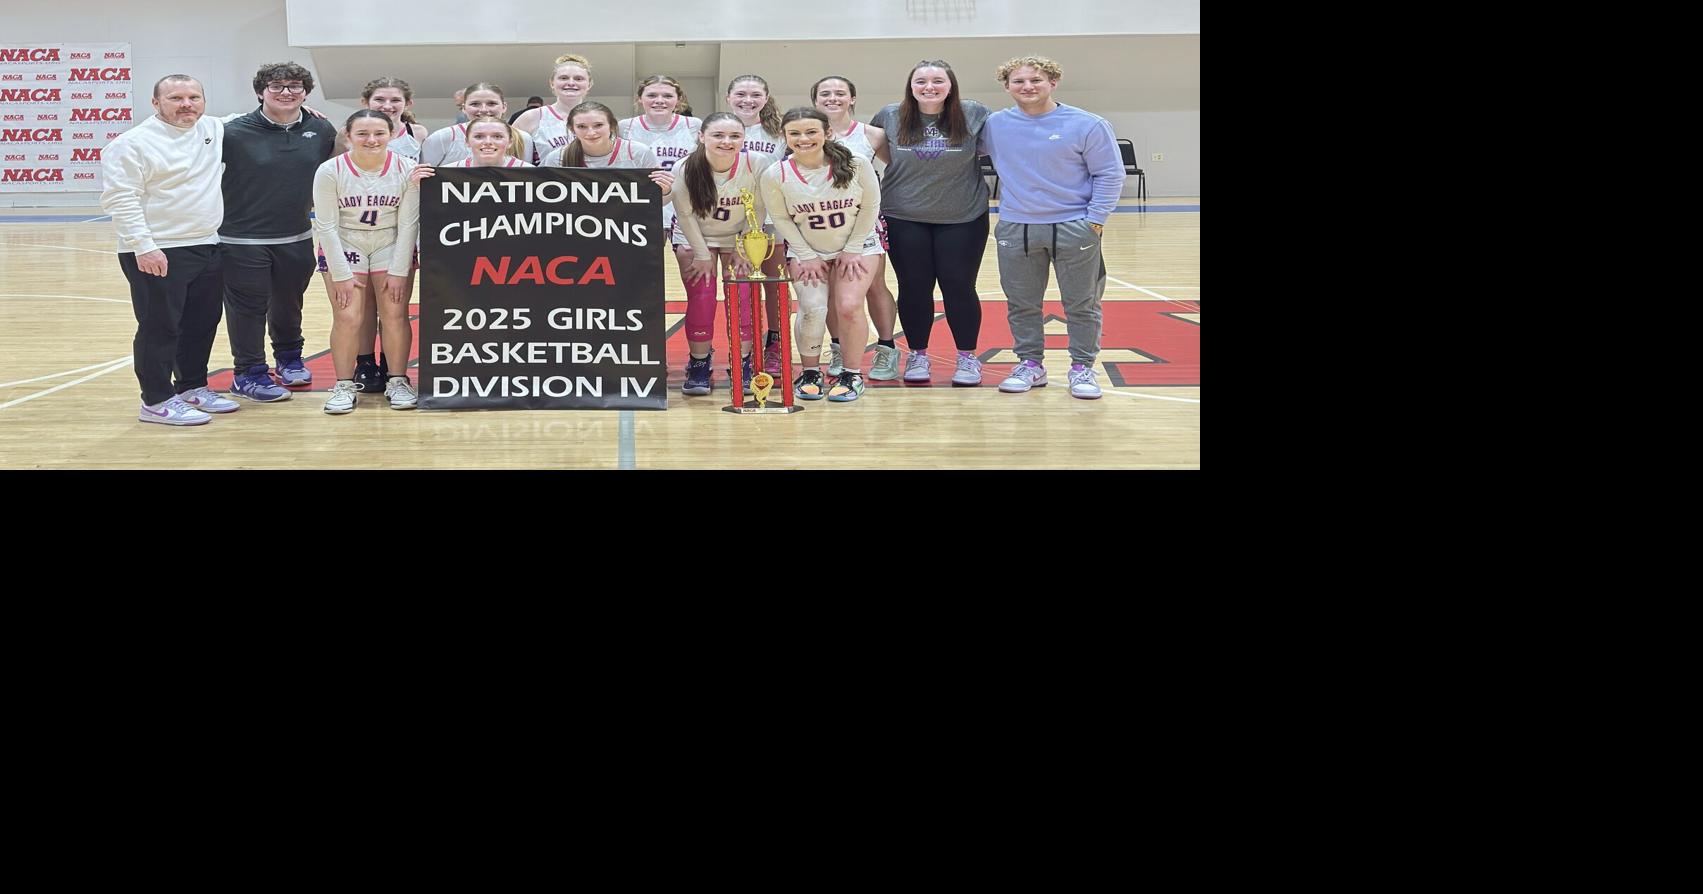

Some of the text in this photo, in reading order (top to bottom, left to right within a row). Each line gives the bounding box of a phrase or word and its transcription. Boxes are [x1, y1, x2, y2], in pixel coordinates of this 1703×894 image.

[0, 48, 60, 61] NACA
[68, 67, 131, 81] NACA
[0, 88, 61, 101] NACA
[69, 108, 132, 121] NACA
[0, 128, 63, 141] NACA
[548, 136, 569, 148] LADY
[70, 148, 102, 161] NA
[657, 146, 688, 158] EAGLES
[1, 168, 64, 181] NACA
[441, 181, 650, 204] NATIONAL
[720, 196, 745, 207] EAGL
[793, 198, 854, 214] LADY EAGLES
[360, 210, 378, 227] 4
[808, 211, 846, 230] 20
[439, 212, 648, 247] CHAMPIONS
[470, 256, 616, 286] NACA
[443, 307, 644, 331] 2025 GIRLS
[431, 342, 660, 365] BASKETBALL
[433, 376, 658, 398] DIVISION IV
